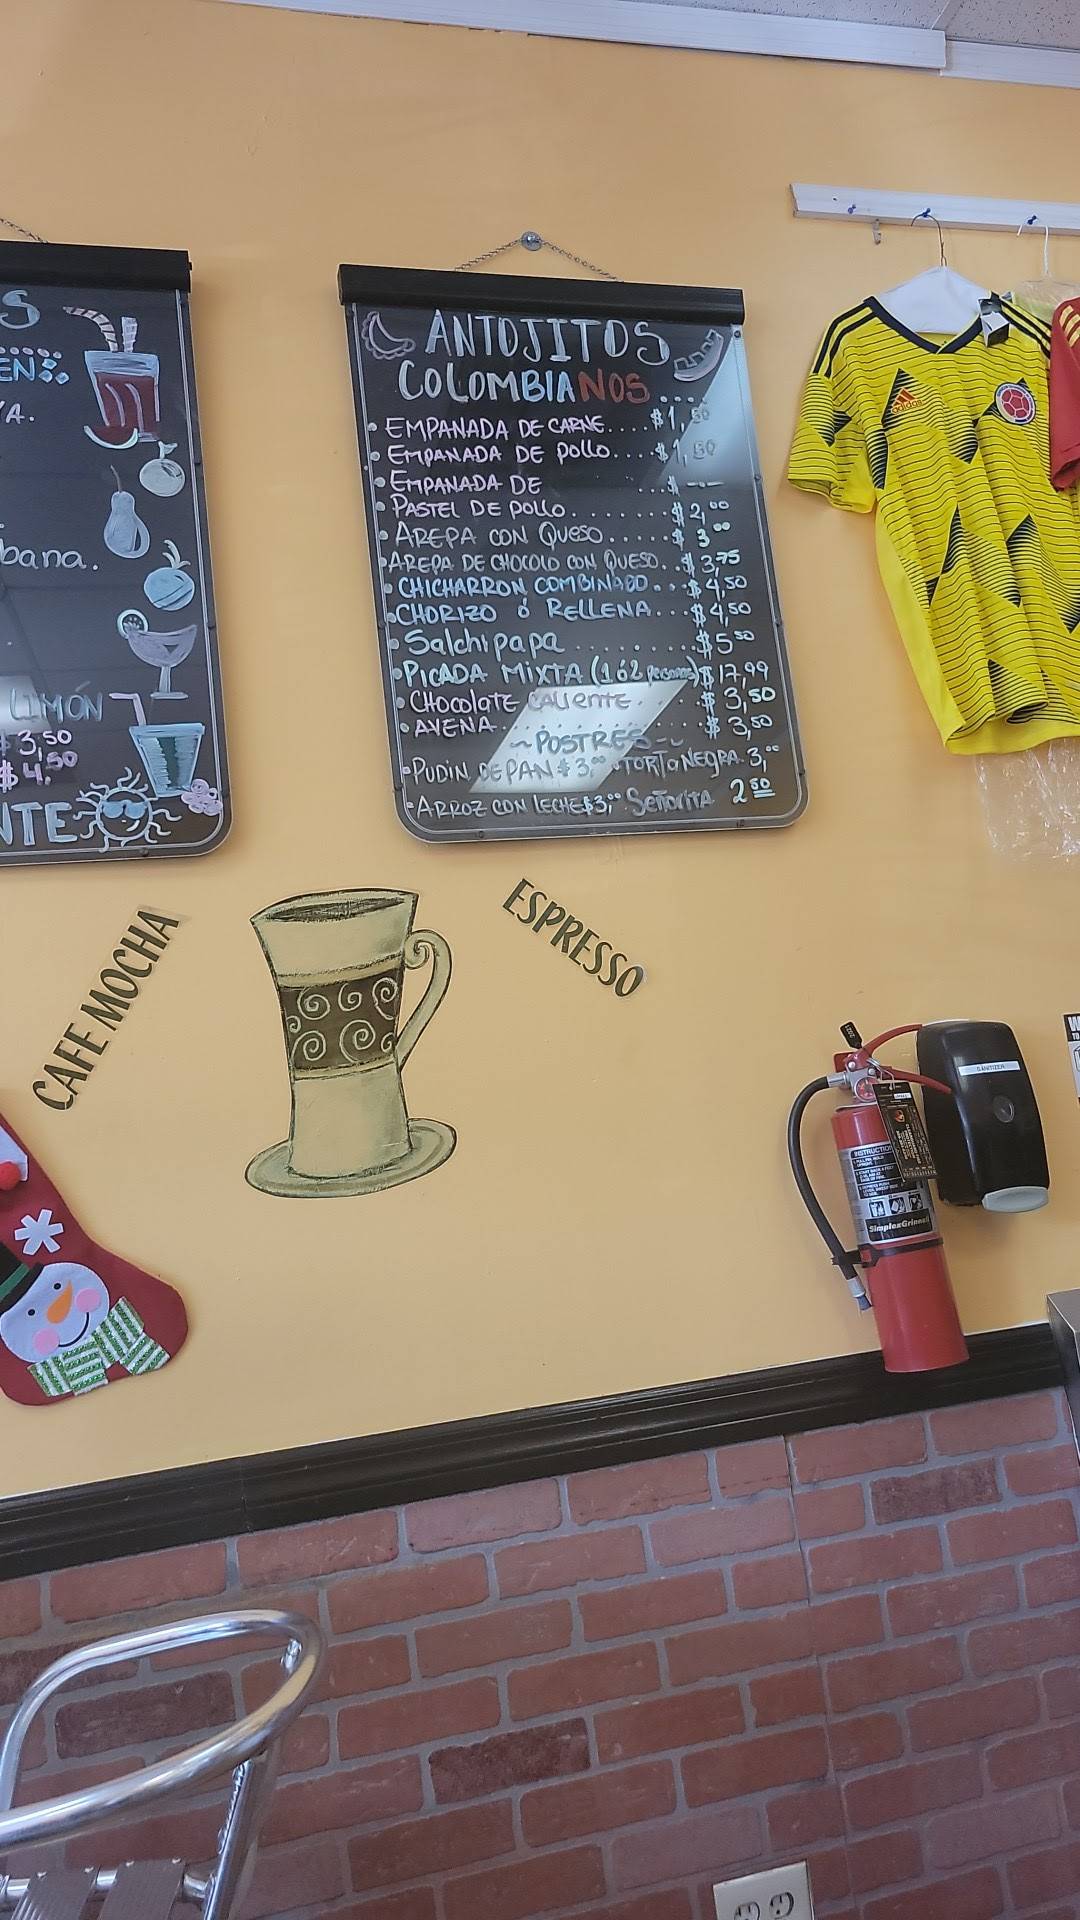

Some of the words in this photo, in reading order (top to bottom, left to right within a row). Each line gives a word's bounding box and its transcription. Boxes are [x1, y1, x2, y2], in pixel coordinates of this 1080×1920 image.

[425, 309, 671, 366] ANTOJITOS
[398, 359, 650, 403] COLOMBIANOS
[891, 398, 923, 414] adidas
[385, 416, 510, 442] EMPANADA
[518, 419, 544, 438] DE
[547, 415, 605, 434] CARNE
[387, 444, 503, 468] EMPANADA
[515, 445, 544, 463] DE
[389, 469, 504, 496] EMPANADA
[509, 475, 542, 495] DE
[390, 493, 461, 519] PASTEL
[470, 500, 501, 516] DE
[395, 520, 477, 549] AREPA
[488, 525, 529, 547] CON
[388, 551, 455, 575] AREPA
[461, 553, 485, 573] DE
[567, 553, 597, 571] CON
[604, 549, 659, 577] QUESO
[395, 603, 498, 626] CHORIZO
[414, 716, 498, 738] AVENA
[506, 758, 553, 785] PAN
[417, 795, 488, 819] ARROZ
[492, 798, 528, 816] CON
[503, 878, 644, 997] ESPRESSO
[33, 1022, 109, 1111] CAFE
[80, 910, 179, 1032] MOCHA
